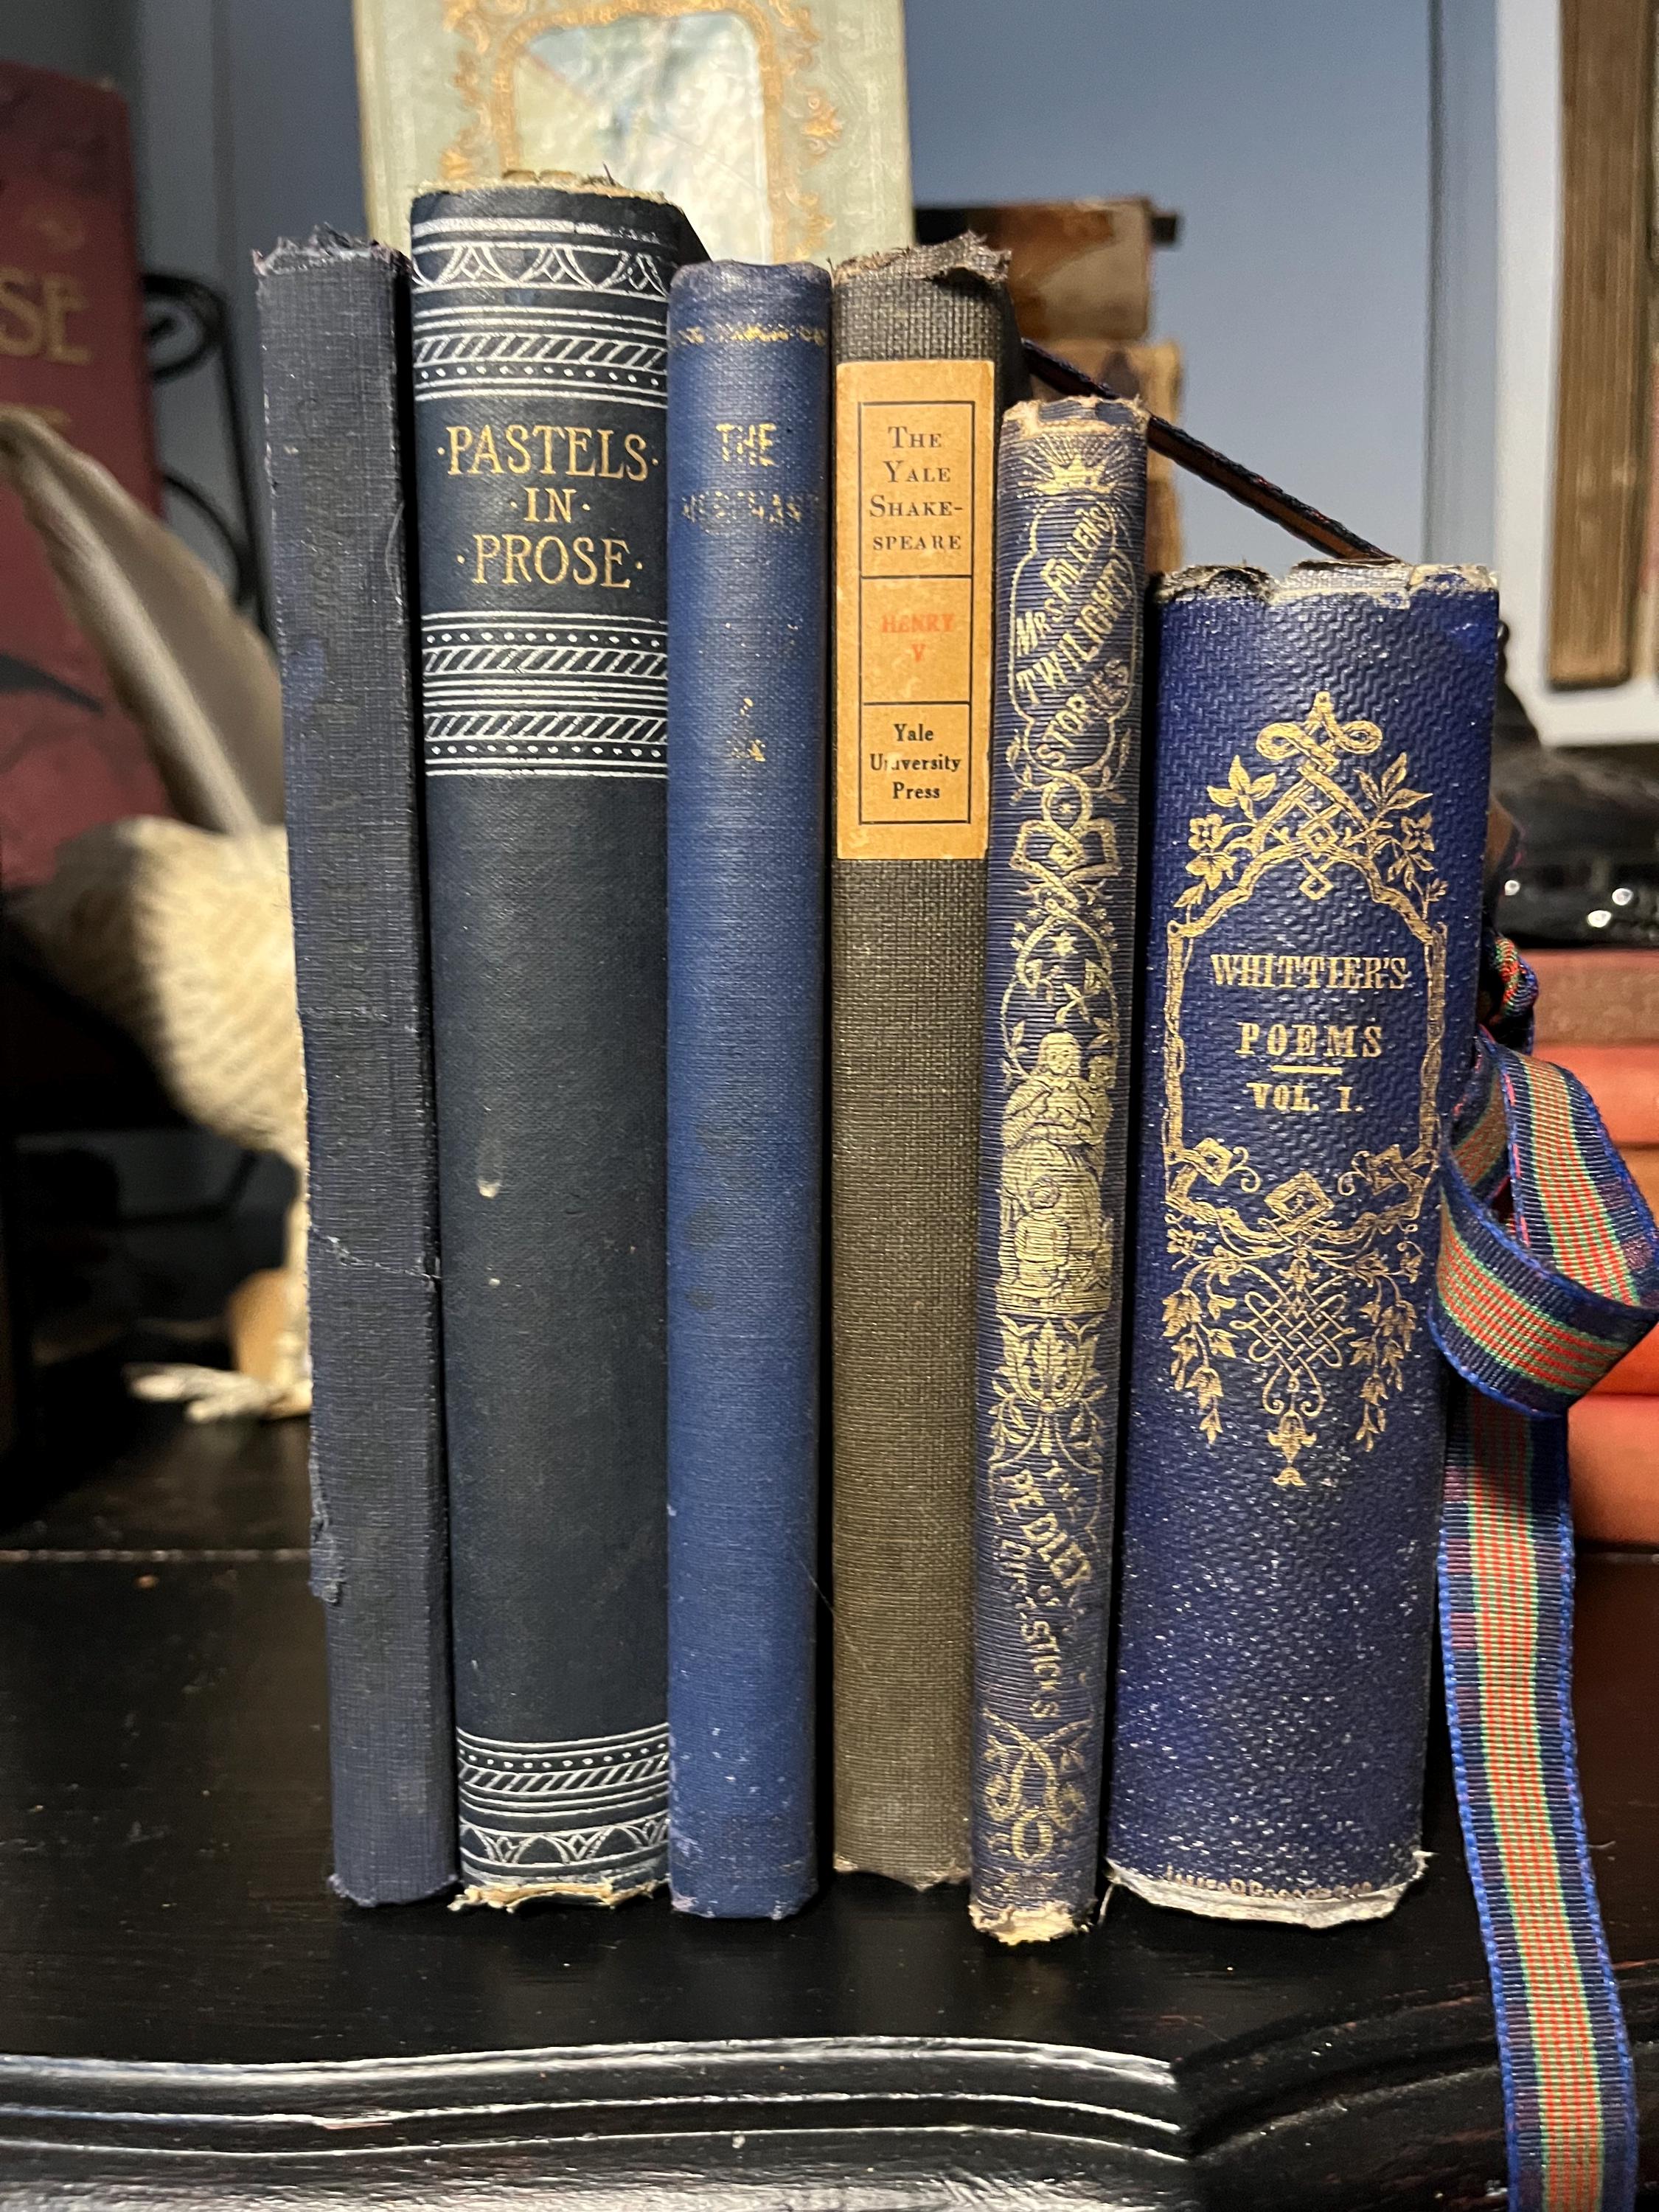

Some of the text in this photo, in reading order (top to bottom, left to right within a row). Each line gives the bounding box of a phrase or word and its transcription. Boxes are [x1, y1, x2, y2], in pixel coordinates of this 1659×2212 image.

[447, 423, 647, 481] PASTELS
[715, 422, 777, 467] THE
[888, 425, 942, 450] THE
[883, 461, 951, 484] YALE
[523, 487, 577, 524] IN
[869, 495, 964, 518] SHAKE-
[872, 535, 961, 551] SPEARE
[472, 534, 630, 588] PROSE
[880, 612, 954, 633] HENRY
[1015, 558, 1133, 706] TWILIGHT
[912, 644, 926, 663] V
[1036, 660, 1129, 769] STORIES
[894, 723, 934, 743] Yale
[892, 782, 941, 800] Press
[1210, 953, 1411, 990] WHITTIER'S
[1234, 1022, 1383, 1057] POEMS
[1246, 1082, 1364, 1113] VOL. I.
